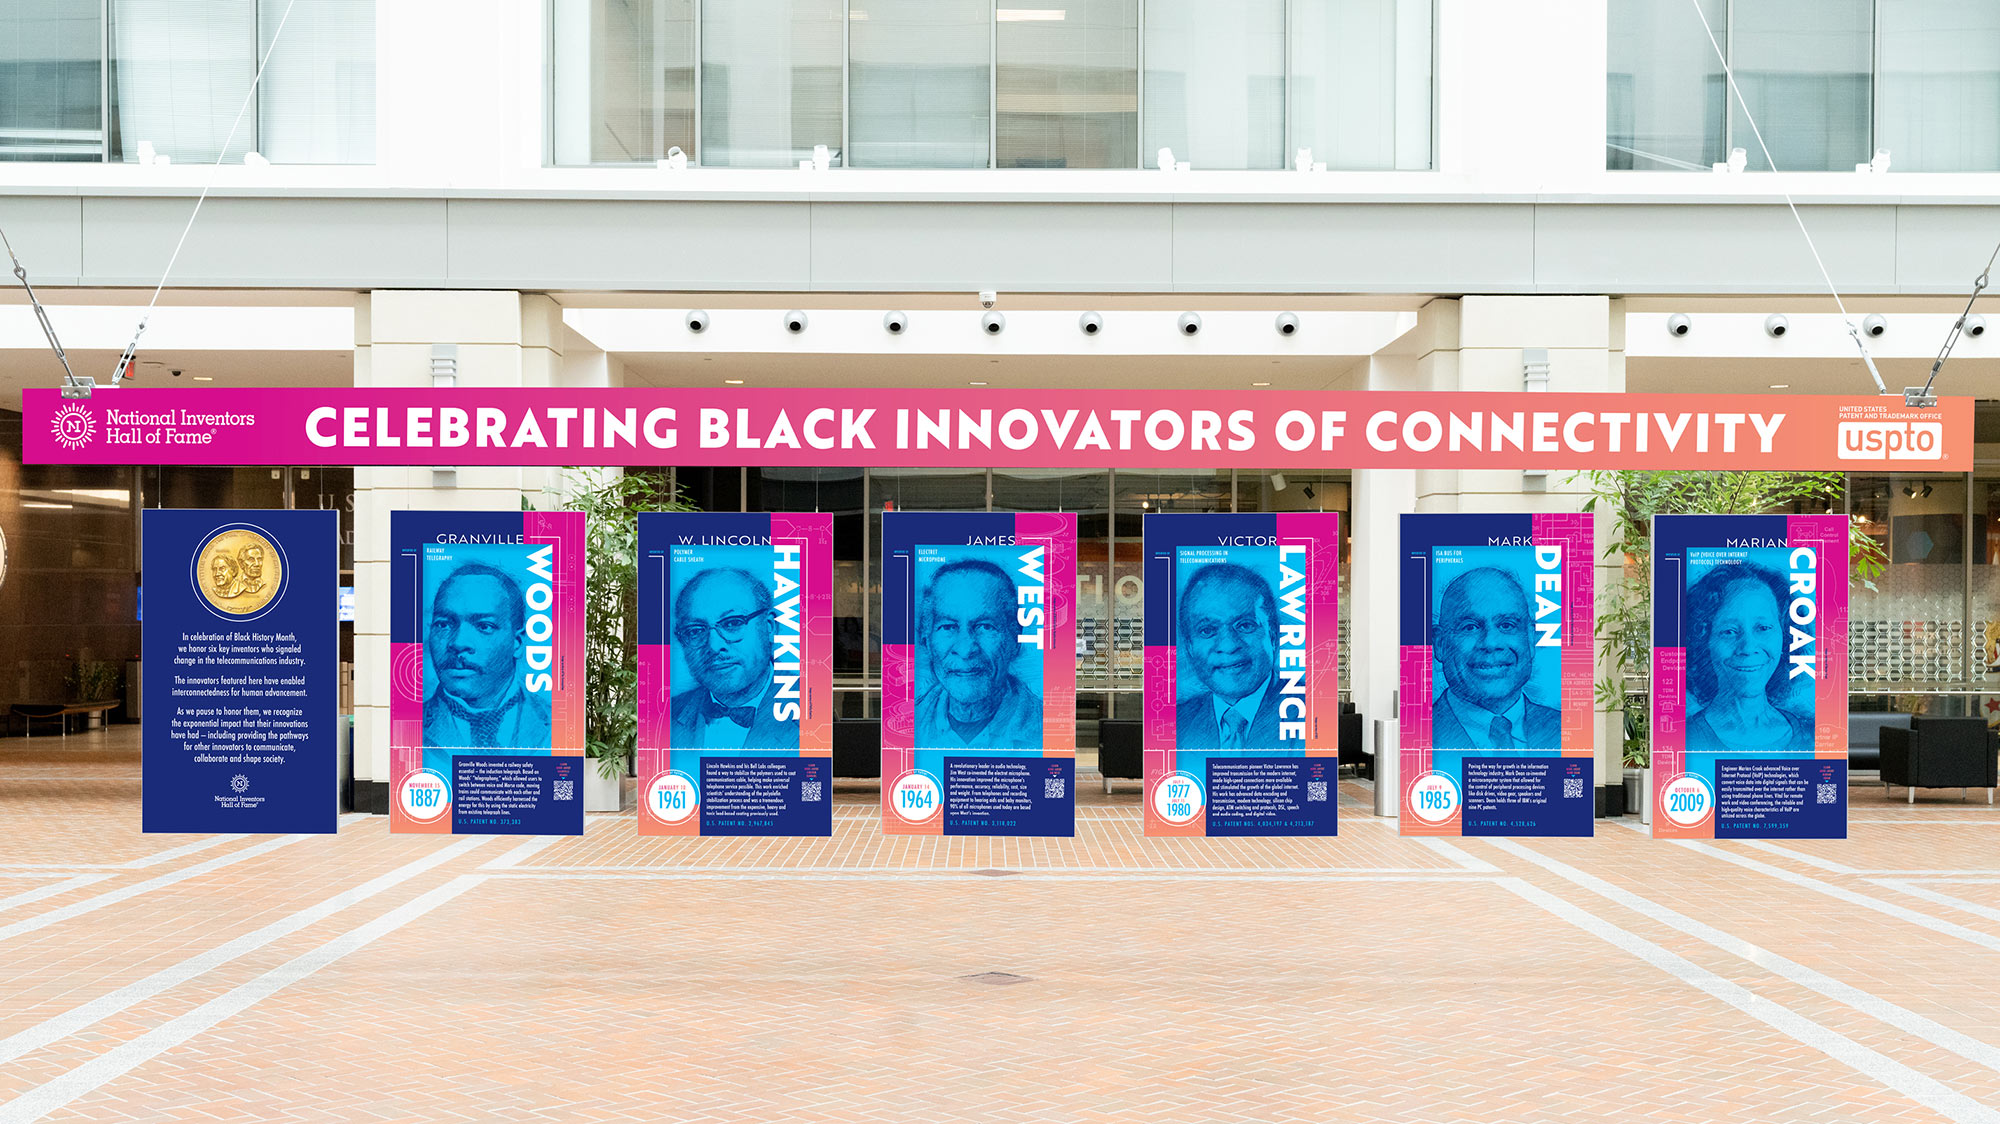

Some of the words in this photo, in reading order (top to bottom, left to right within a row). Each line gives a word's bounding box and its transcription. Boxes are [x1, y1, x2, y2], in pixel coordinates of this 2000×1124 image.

[106, 409, 176, 425] National
[181, 410, 254, 425] Inventors
[106, 428, 142, 443] Hall
[146, 428, 160, 443] of
[306, 407, 677, 448] CELEBRATING
[700, 408, 876, 449] BLACK
[897, 409, 1255, 451] INNOVATORS
[1275, 410, 1346, 451] OF
[1366, 411, 1786, 454] CONNECTIVITY
[436, 533, 524, 544] GRANVILLE
[678, 535, 696, 546] W.
[702, 535, 771, 546] LINCOLN
[966, 535, 1015, 546] JAMES
[1218, 536, 1277, 546] VICTOR
[1488, 536, 1532, 546] MARK
[1727, 537, 1787, 548] MARIAN
[1018, 546, 1044, 650] WEST
[1535, 546, 1561, 646] DEAN
[526, 544, 553, 692] WOODS
[1789, 547, 1816, 679] CROAK
[182, 632, 189, 641] In
[190, 632, 224, 641] celebration
[226, 632, 233, 641] of
[234, 632, 251, 641] Black
[252, 633, 274, 643] History
[275, 632, 297, 643] Month,
[773, 545, 800, 722] HAWKINS
[1279, 545, 1306, 740] LAWRENCE
[188, 643, 207, 653] honor
[208, 645, 217, 653] six
[219, 643, 230, 655] key
[231, 645, 260, 653] inventors
[261, 644, 274, 653] who
[275, 644, 301, 655] signaled
[174, 655, 196, 666] change
[197, 656, 204, 664] in
[205, 655, 215, 664] the
[216, 655, 277, 665] telecommunications
[279, 655, 306, 667] industry.
[174, 675, 186, 684] The
[187, 676, 219, 685] innovators
[221, 675, 247, 685] featured
[248, 675, 263, 685] here
[264, 676, 279, 685] have
[280, 676, 305, 685] enabled
[172, 687, 230, 696] interconnectedness
[231, 687, 240, 696] for
[241, 687, 263, 697] human
[265, 687, 307, 697] advancement.
[177, 707, 184, 715] As
[196, 709, 214, 717] pause
[224, 706, 242, 716] honor
[243, 706, 261, 717] them,
[273, 708, 303, 717] recognize
[171, 718, 182, 727] the
[183, 718, 219, 729] exponential
[220, 719, 241, 729] impact
[243, 718, 255, 728] that
[257, 718, 271, 728] their
[273, 719, 308, 728] innovations
[171, 730, 186, 739] have
[187, 730, 199, 739] had
[208, 730, 236, 741] including
[237, 730, 266, 741] providing
[268, 730, 278, 739] the
[279, 730, 309, 741] pathways
[183, 742, 193, 751] for
[194, 742, 210, 751] other
[212, 743, 244, 751] innovators
[253, 743, 296, 752] communicate,
[194, 753, 228, 763] collaborate
[229, 753, 242, 763] and
[243, 753, 261, 764] shape
[263, 754, 285, 765] society.
[1168, 784, 1190, 798] 1977
[410, 789, 440, 807] 1887
[658, 791, 685, 808] 1961
[901, 790, 932, 808] 1964
[1419, 791, 1450, 809] 1985
[1670, 794, 1704, 812] 2009
[1168, 803, 1190, 816] 1980
